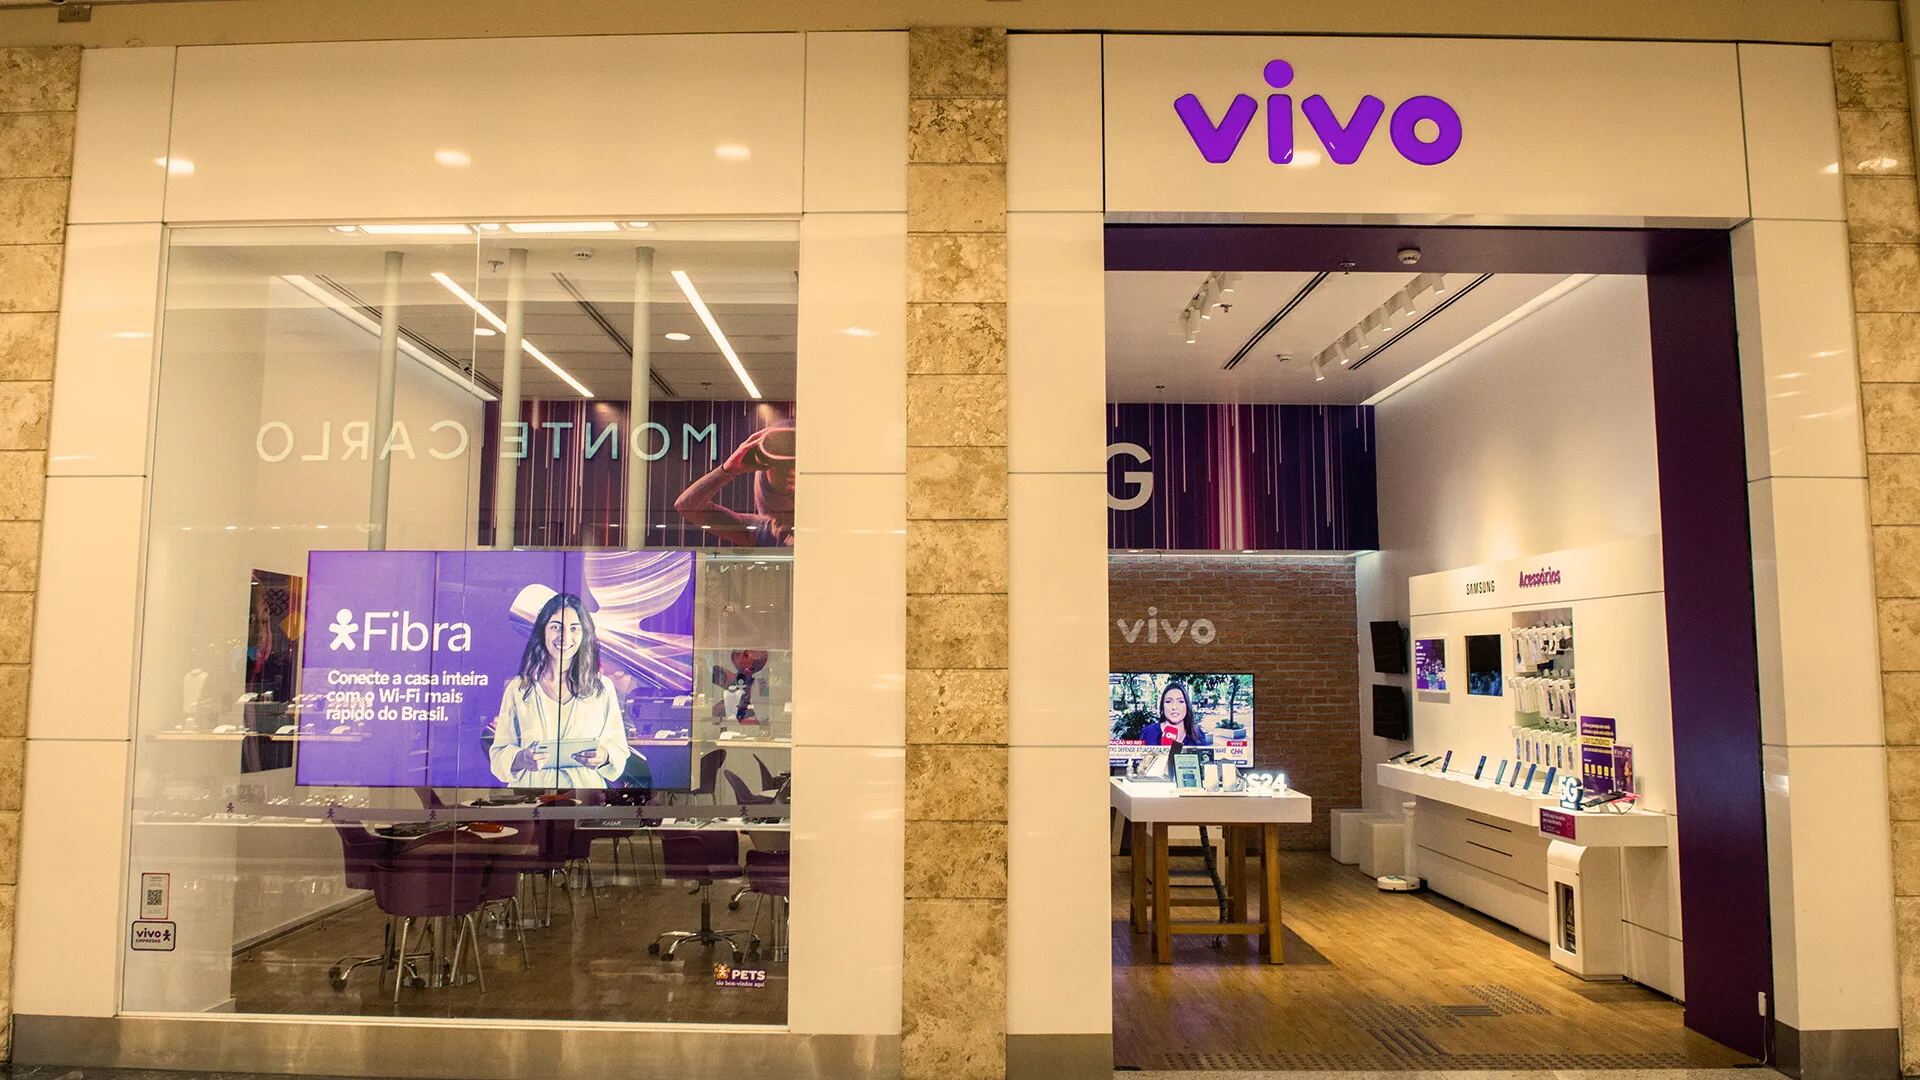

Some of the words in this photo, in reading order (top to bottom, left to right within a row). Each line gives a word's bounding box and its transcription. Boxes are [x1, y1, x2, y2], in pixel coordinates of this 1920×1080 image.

[1174, 59, 1462, 165] vivo
[1519, 566, 1561, 588] Acessórios
[1466, 580, 1495, 596] SAMSUNG
[363, 610, 471, 652] Fibra
[1116, 606, 1216, 644] vivo
[327, 669, 389, 685] Conecte
[392, 673, 401, 685] a
[404, 673, 438, 686] casa
[442, 670, 489, 686] inteira
[326, 690, 360, 702] com
[365, 690, 375, 703] o
[379, 687, 420, 703] Wi-Fi
[425, 688, 463, 704] mais
[325, 703, 375, 723] rápido
[377, 705, 398, 721] do
[401, 705, 449, 722] Brasil.
[1559, 776, 1580, 803] 5G
[136, 928, 161, 938] vivo
[731, 969, 766, 981] PETS
